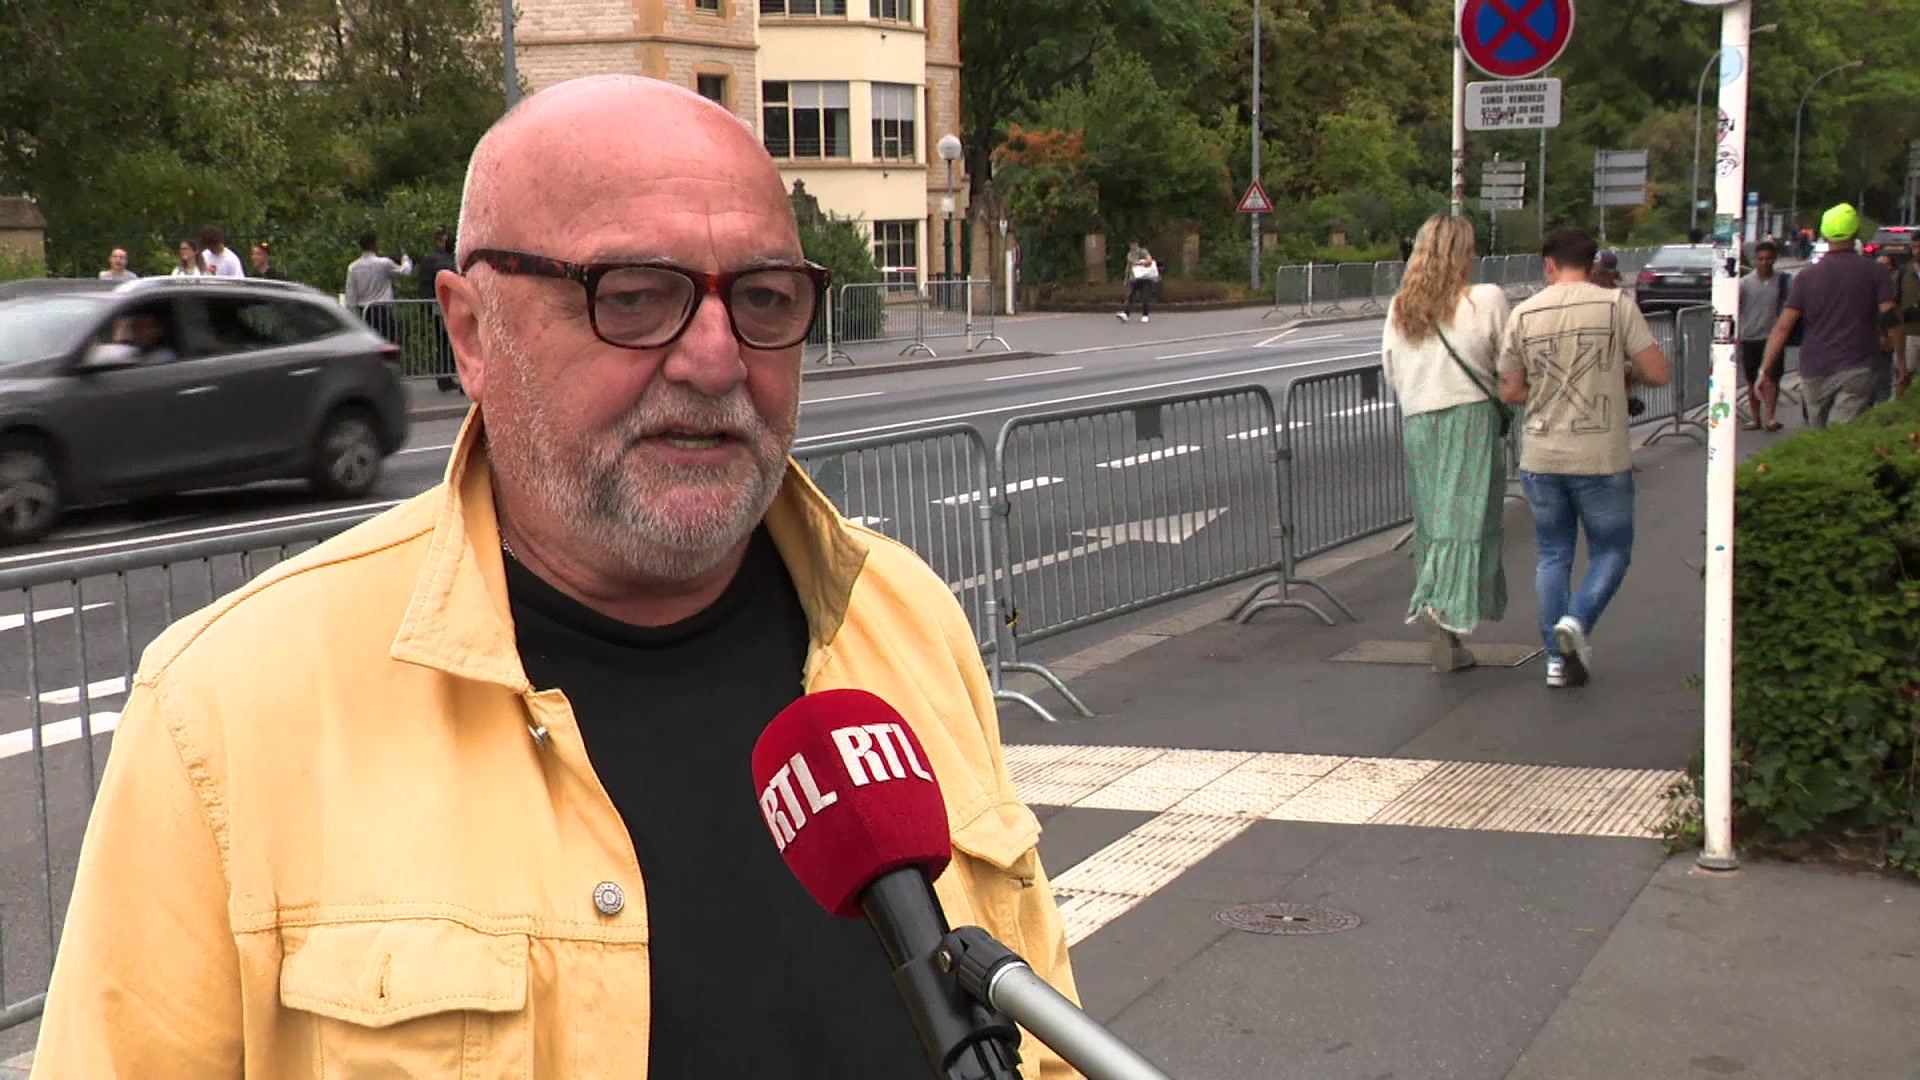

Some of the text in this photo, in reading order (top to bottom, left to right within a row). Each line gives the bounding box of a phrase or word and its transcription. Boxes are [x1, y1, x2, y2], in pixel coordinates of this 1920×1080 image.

[1482, 96, 1503, 105] LUNDI
[1509, 95, 1544, 104] VENDREDI
[1505, 83, 1547, 93] OUVRABLES
[831, 723, 934, 787] RTL
[759, 752, 838, 853] RTL
